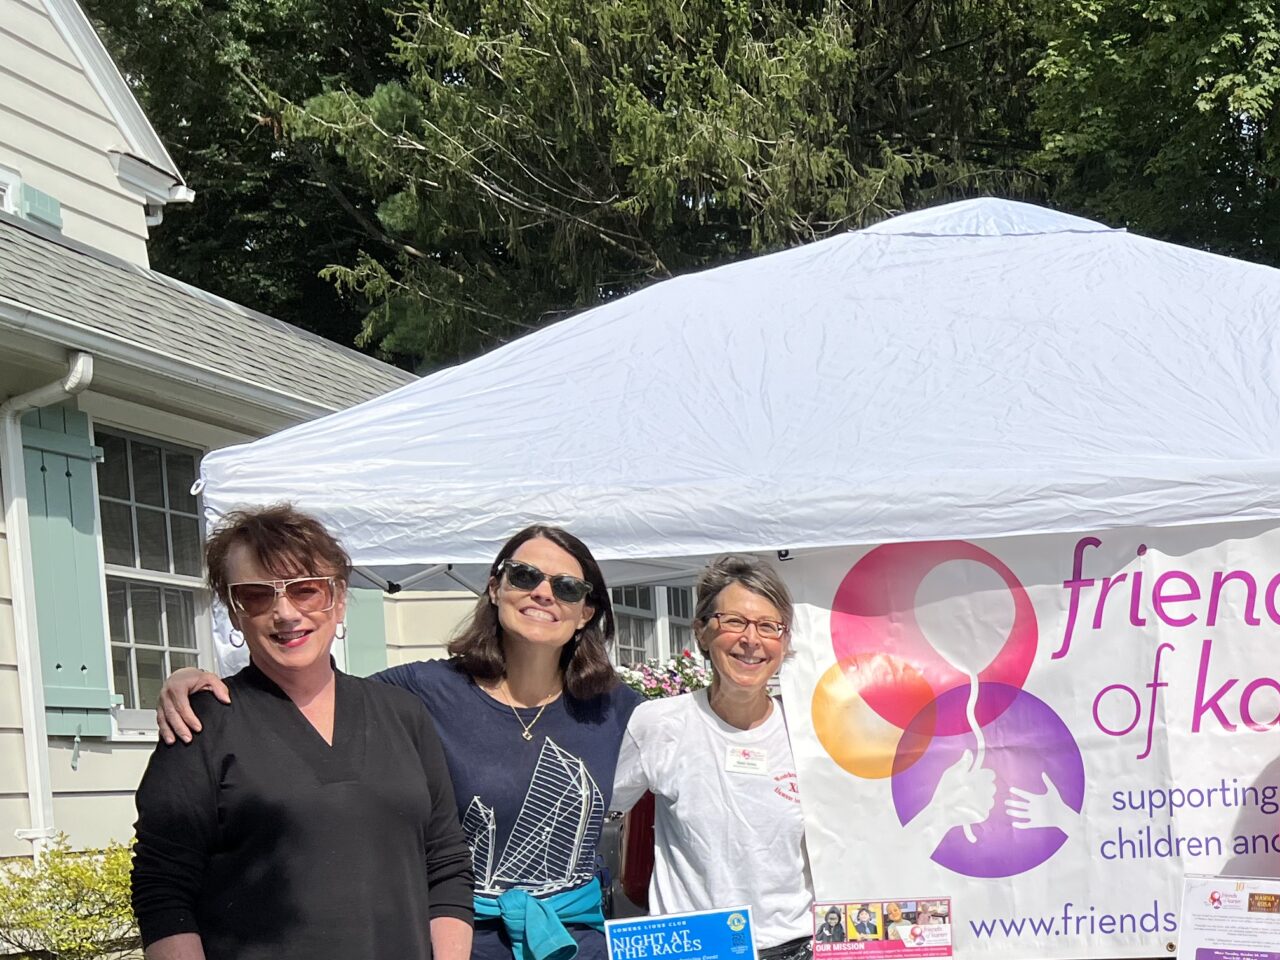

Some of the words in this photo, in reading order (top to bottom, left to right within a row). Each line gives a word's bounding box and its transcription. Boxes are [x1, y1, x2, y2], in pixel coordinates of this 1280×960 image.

[1092, 642, 1175, 760] of
[1111, 778, 1279, 818] supporting
[1100, 825, 1222, 860] children
[613, 932, 666, 951] NIGHT
[670, 930, 690, 943] AT
[613, 946, 648, 960] THE
[653, 939, 702, 956] RACES
[833, 942, 865, 951] MISSION
